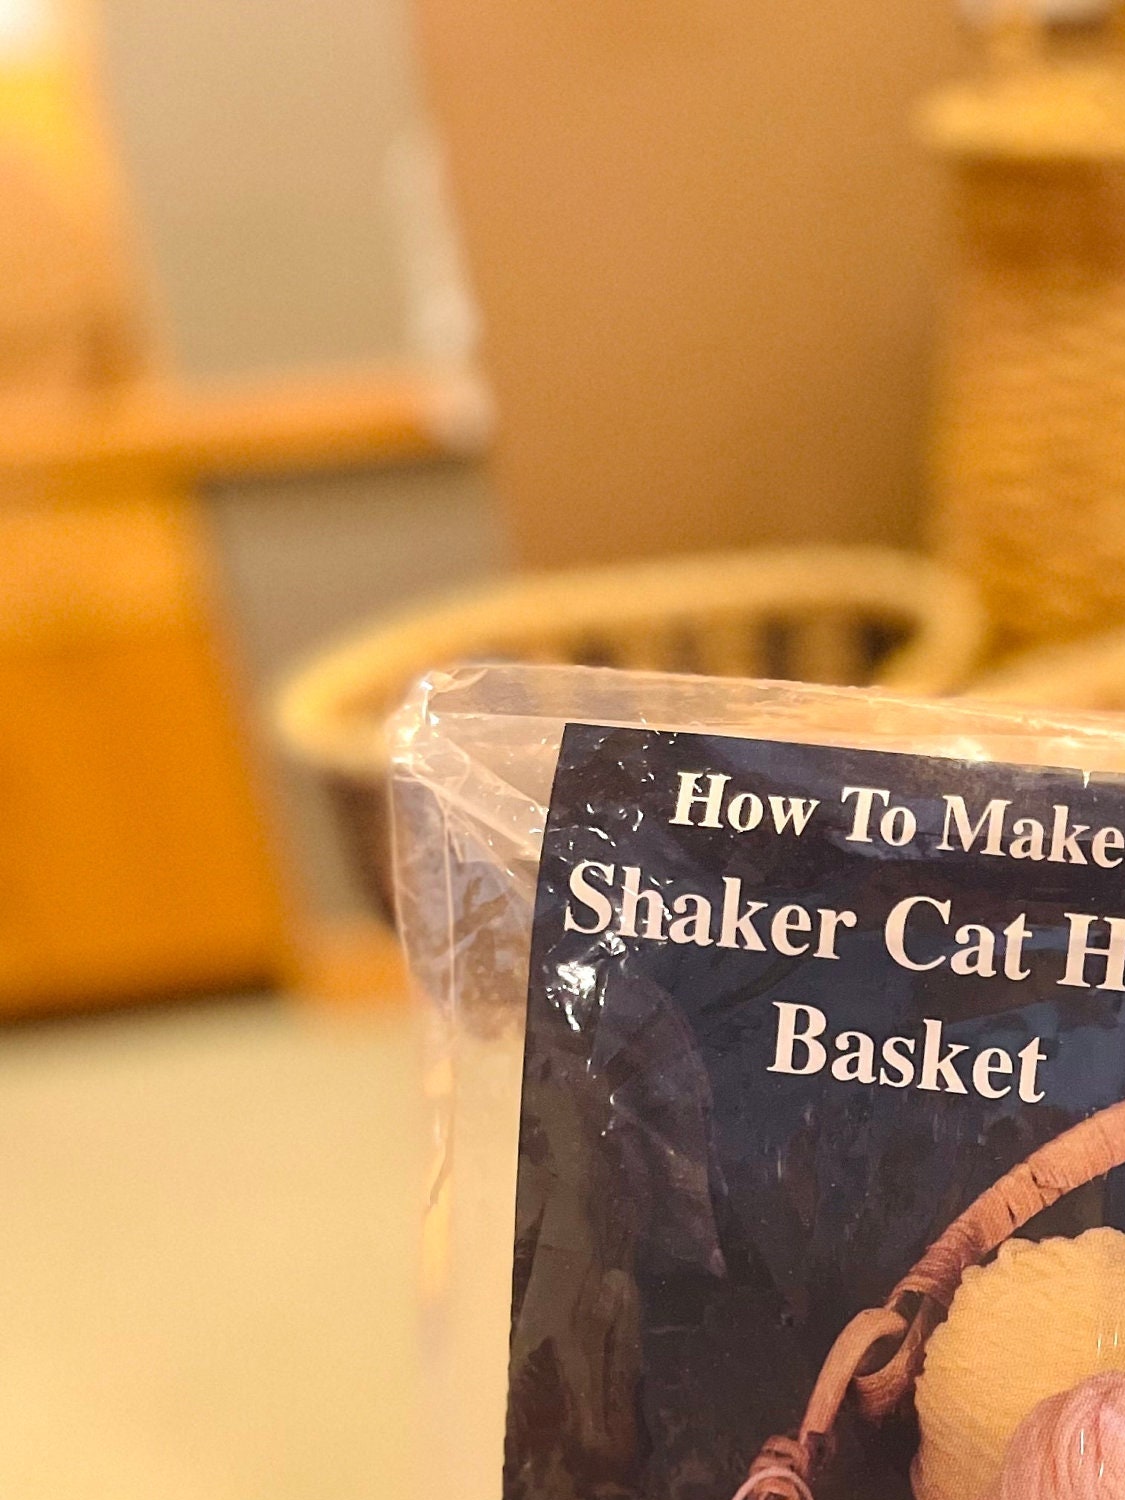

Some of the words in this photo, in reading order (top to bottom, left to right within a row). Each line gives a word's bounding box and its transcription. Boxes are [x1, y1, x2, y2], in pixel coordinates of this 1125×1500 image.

[669, 771, 820, 837] How
[840, 787, 916, 846] To
[936, 795, 1125, 868] Make
[562, 862, 858, 959] Shaker
[884, 895, 1033, 981] Cat
[766, 1000, 1048, 1104] Basket
